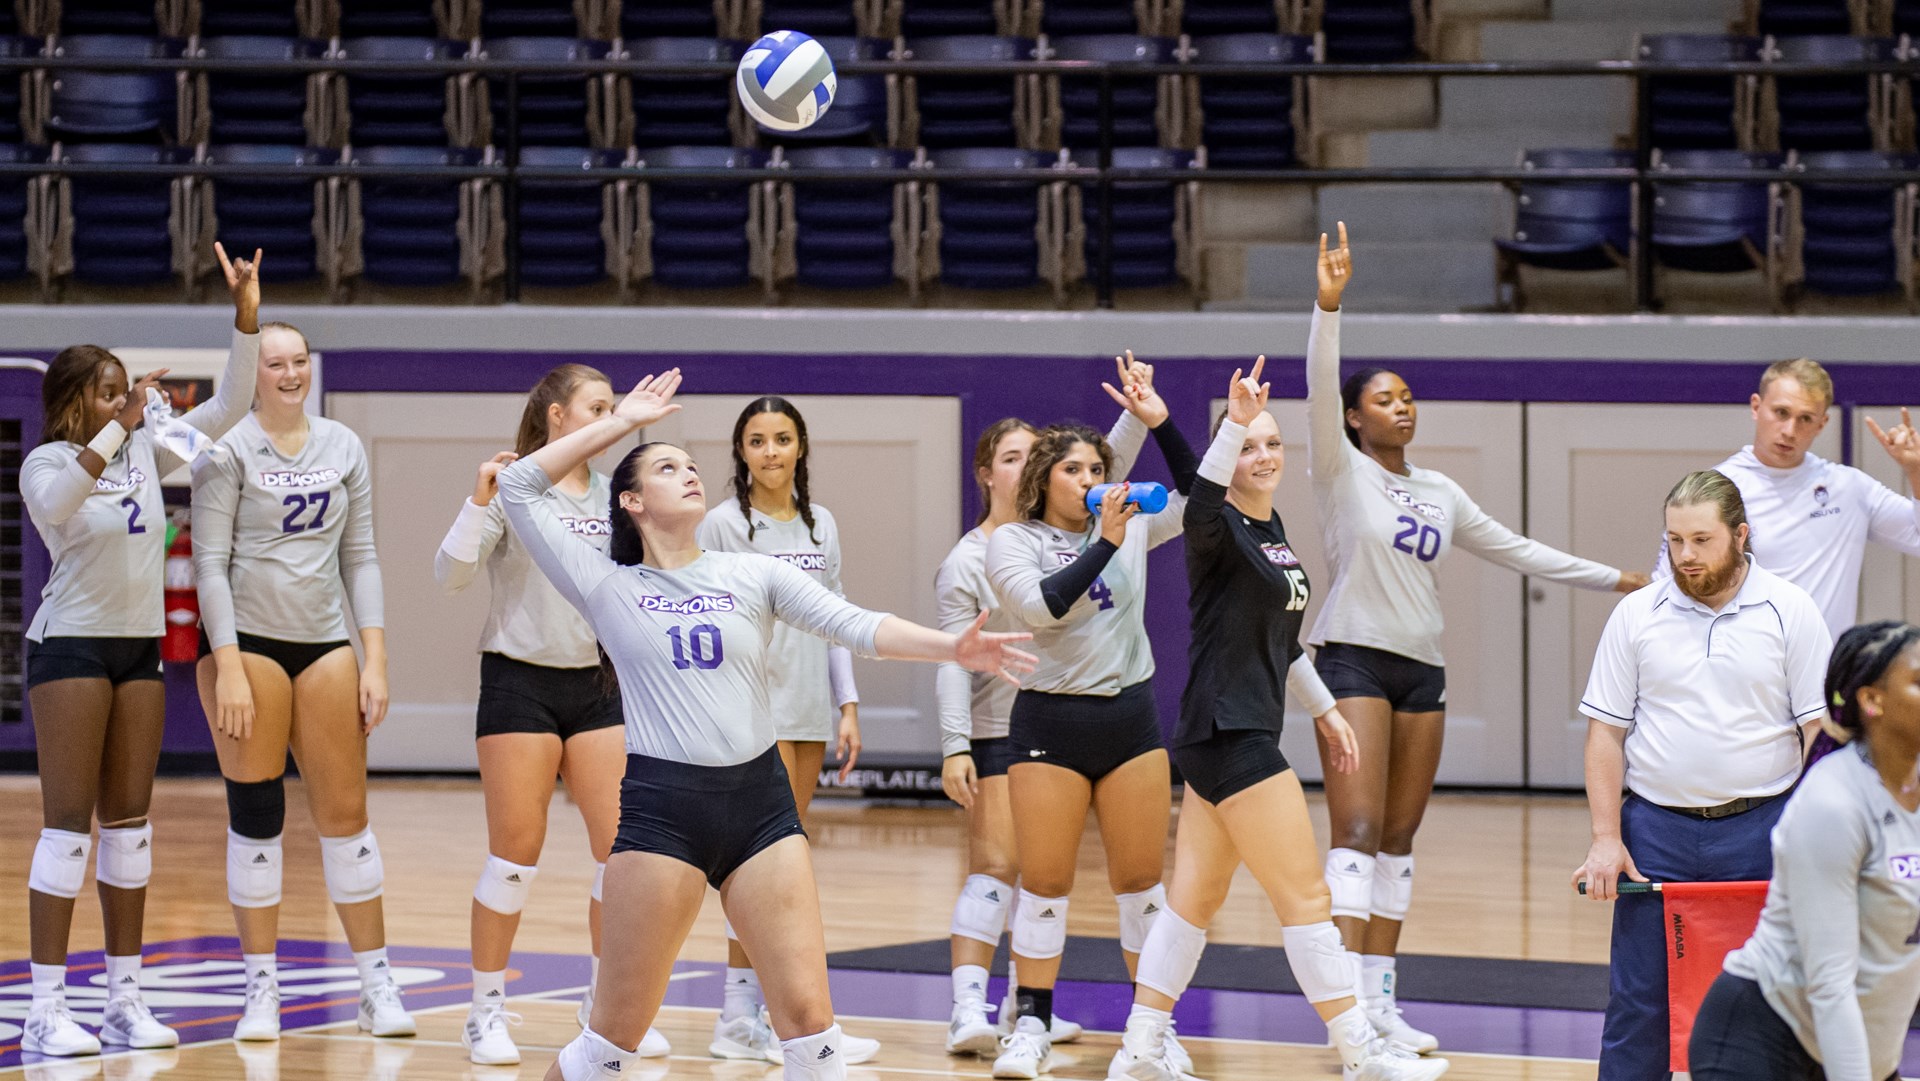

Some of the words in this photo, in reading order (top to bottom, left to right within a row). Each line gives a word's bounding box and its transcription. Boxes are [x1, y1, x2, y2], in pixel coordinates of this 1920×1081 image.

[261, 468, 339, 487] DEMONS
[121, 497, 146, 534] 2
[283, 491, 331, 532] 27
[1393, 515, 1441, 562] 20
[639, 593, 735, 615] DEMONS
[1088, 575, 1115, 611] 4
[1283, 570, 1309, 611] 15
[666, 624, 724, 670] 10
[1672, 913, 1685, 960] MIKASA
